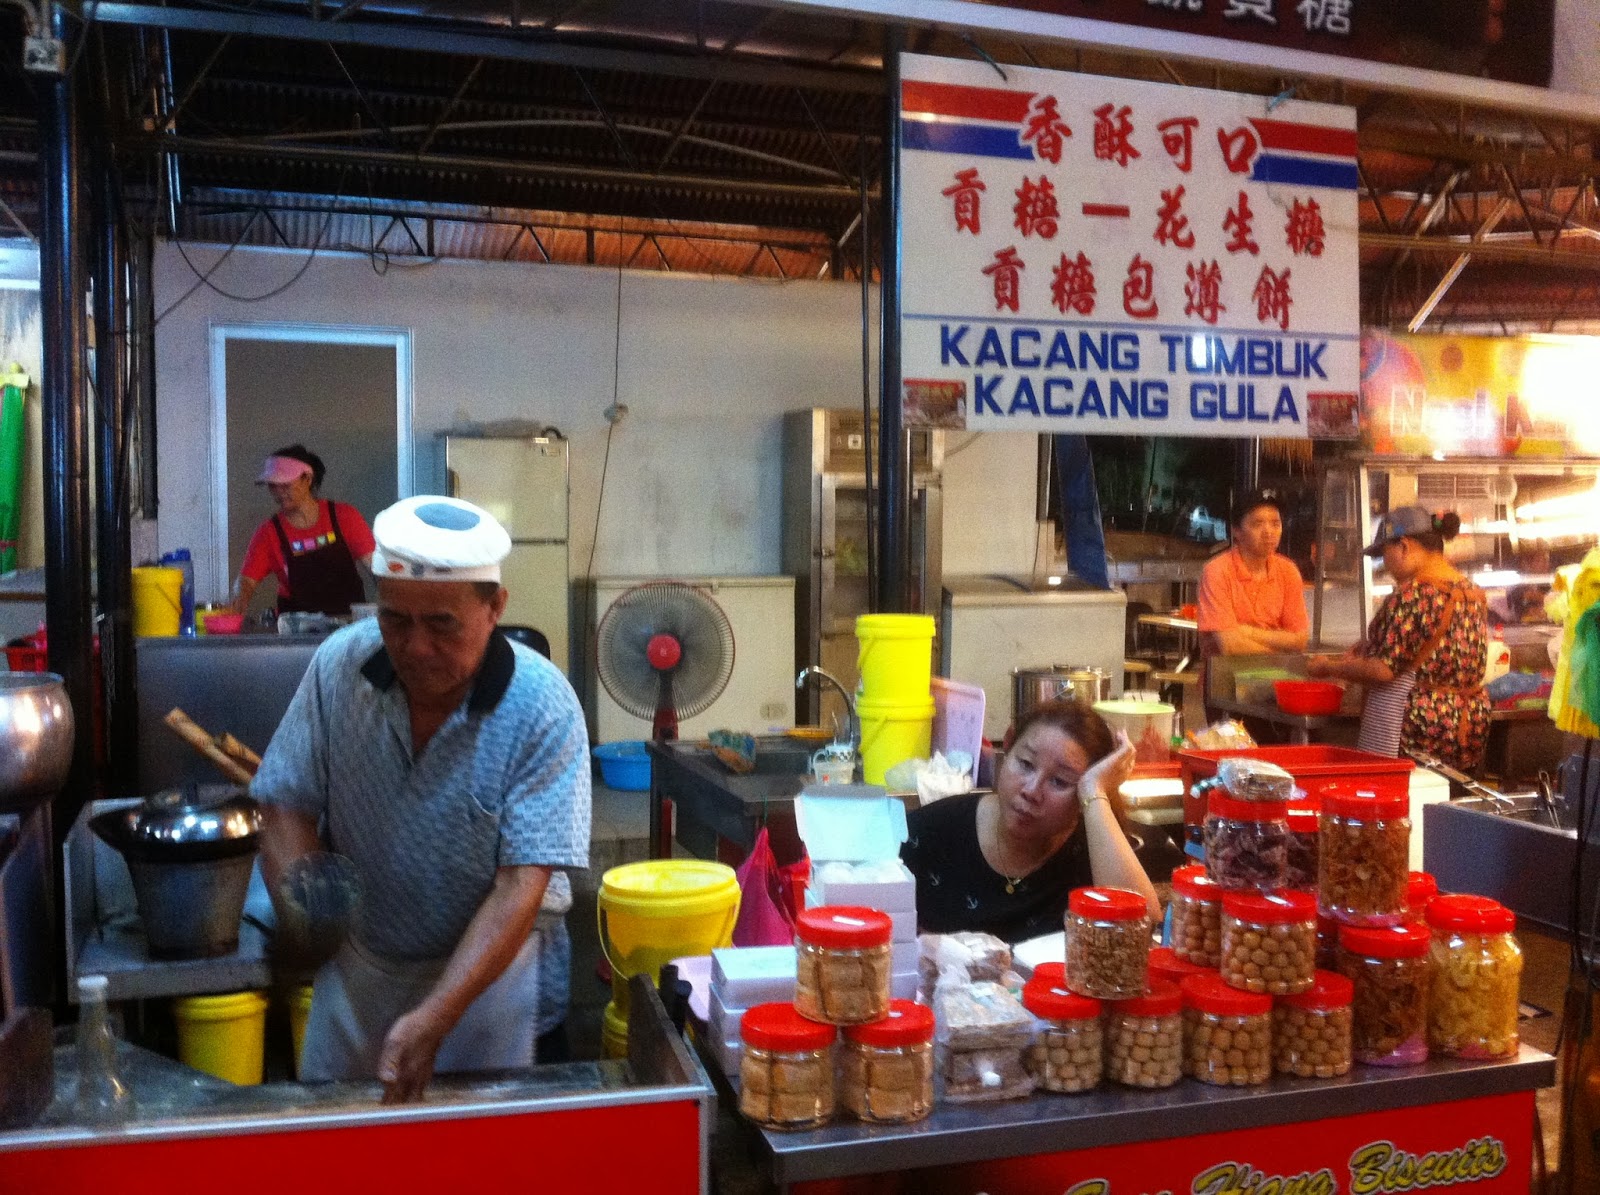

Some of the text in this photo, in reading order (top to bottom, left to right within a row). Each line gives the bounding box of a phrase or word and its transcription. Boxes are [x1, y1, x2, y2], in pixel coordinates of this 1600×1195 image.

[1022, 94, 1258, 173] 香酥可口
[939, 324, 1328, 380] KACANG TUMBUK
[974, 374, 1301, 423] KACANG GULA
[1349, 1137, 1506, 1194] Biscuits
